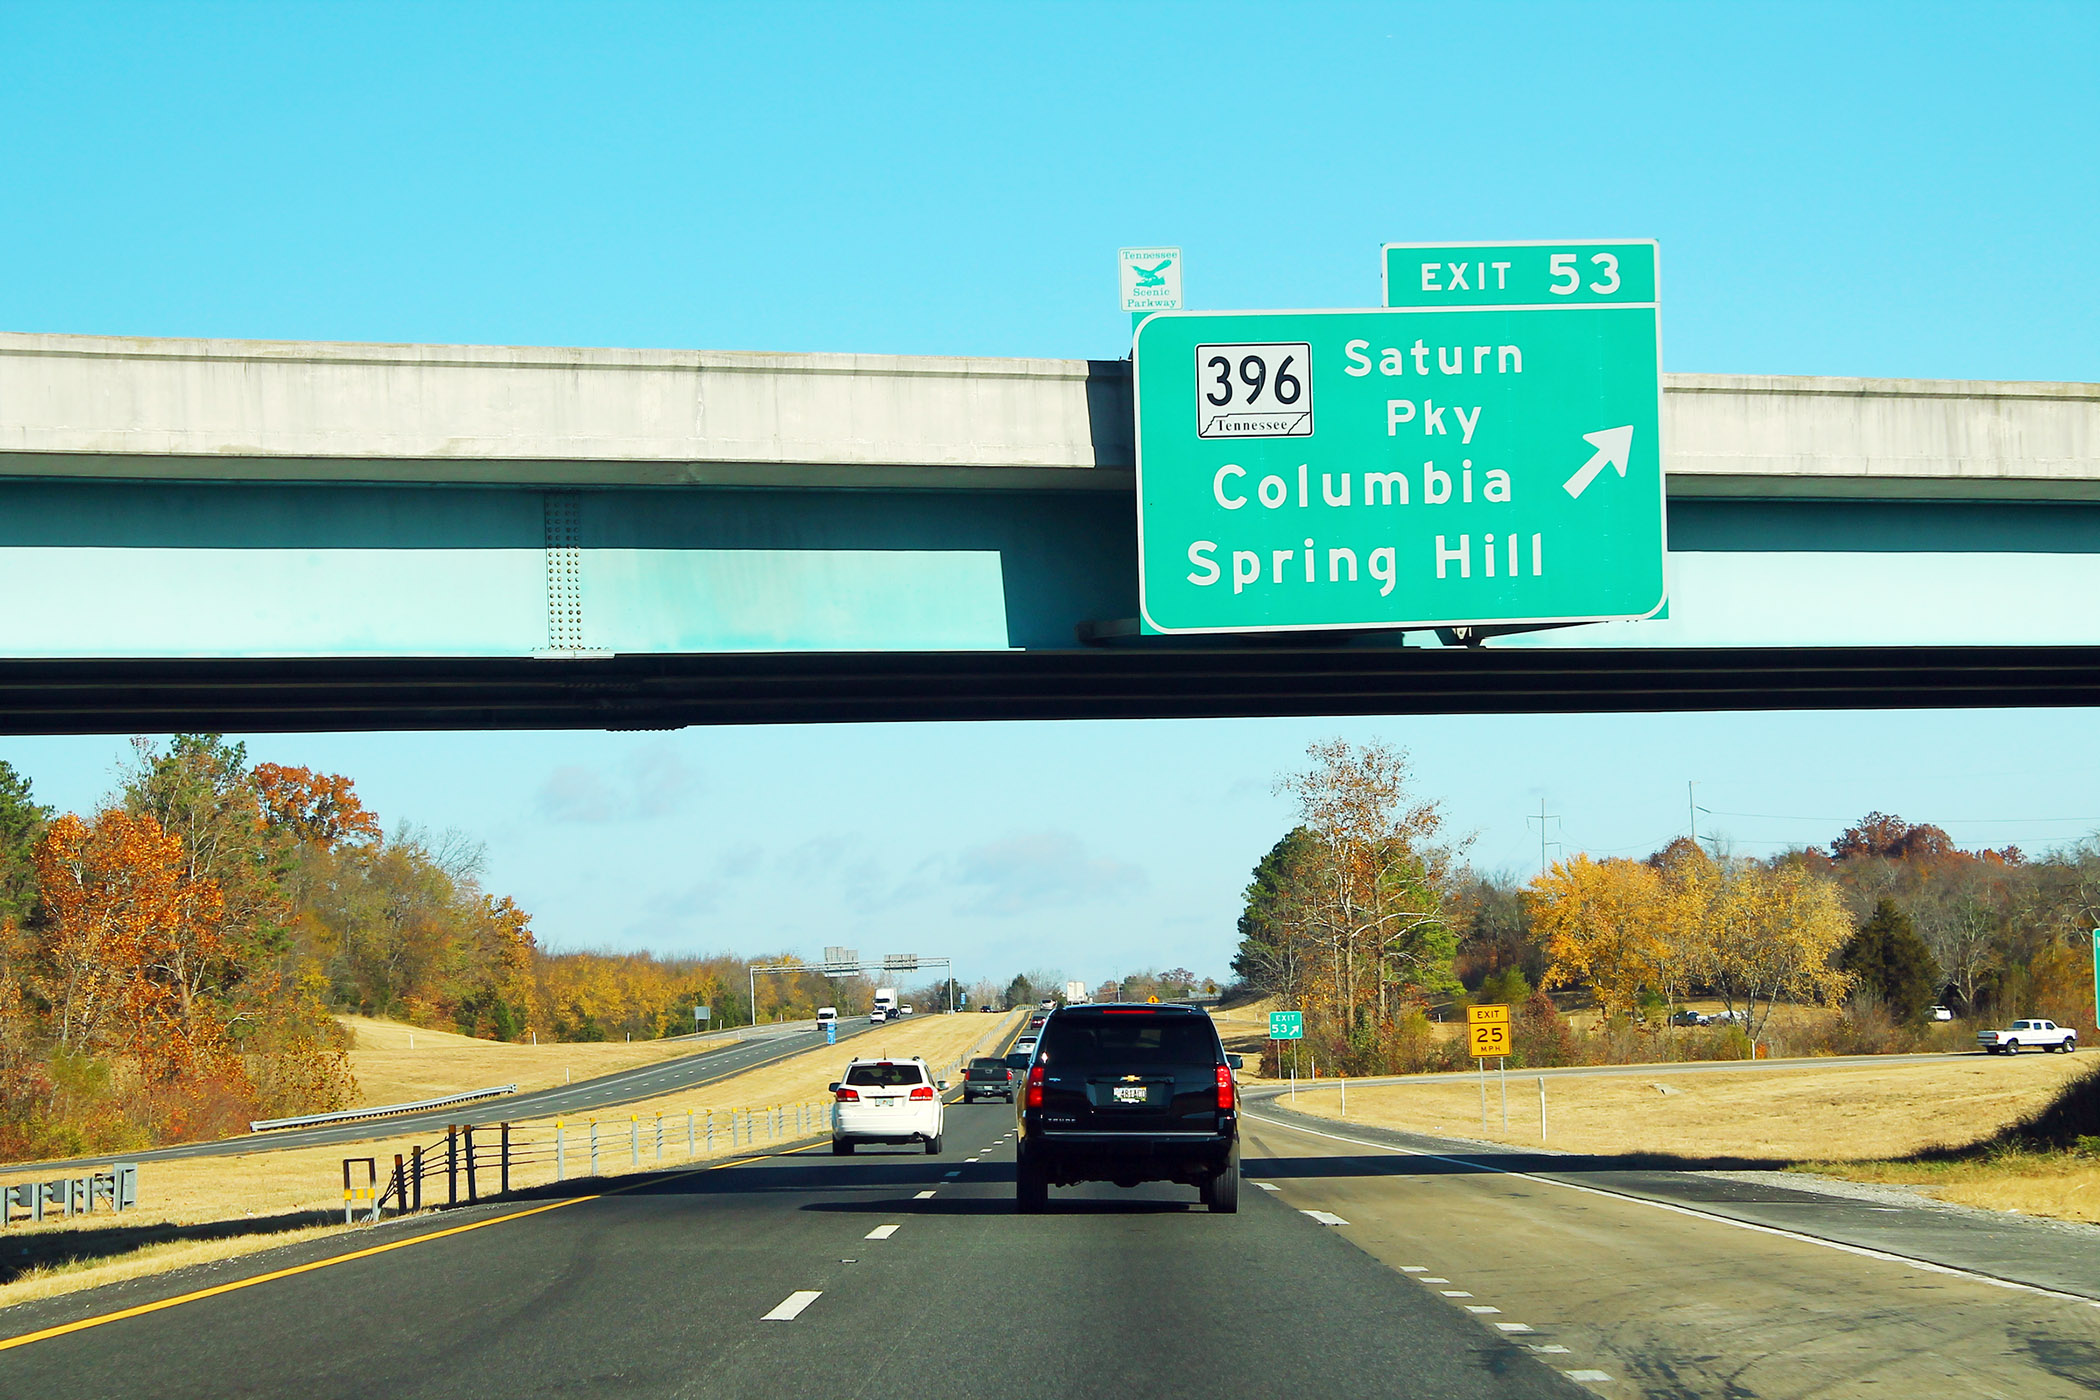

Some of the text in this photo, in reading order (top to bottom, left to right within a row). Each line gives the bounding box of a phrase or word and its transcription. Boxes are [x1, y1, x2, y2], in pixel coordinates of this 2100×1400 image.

[1123, 251, 1177, 260] Tennessee
[1421, 253, 1621, 295] EXIT 53
[1132, 287, 1170, 297] Scenic
[1127, 299, 1176, 308] Parkway
[1343, 339, 1522, 377] Saturn
[1206, 355, 1301, 406] 396
[1217, 419, 1288, 431] Tennessee
[1387, 399, 1482, 444] Pky
[1213, 459, 1511, 510] Columbia
[1186, 533, 1542, 597] Spring Hill
[1477, 1010, 1500, 1019] EXIT
[1271, 1024, 1288, 1033] 53
[1476, 1027, 1503, 1042] 25
